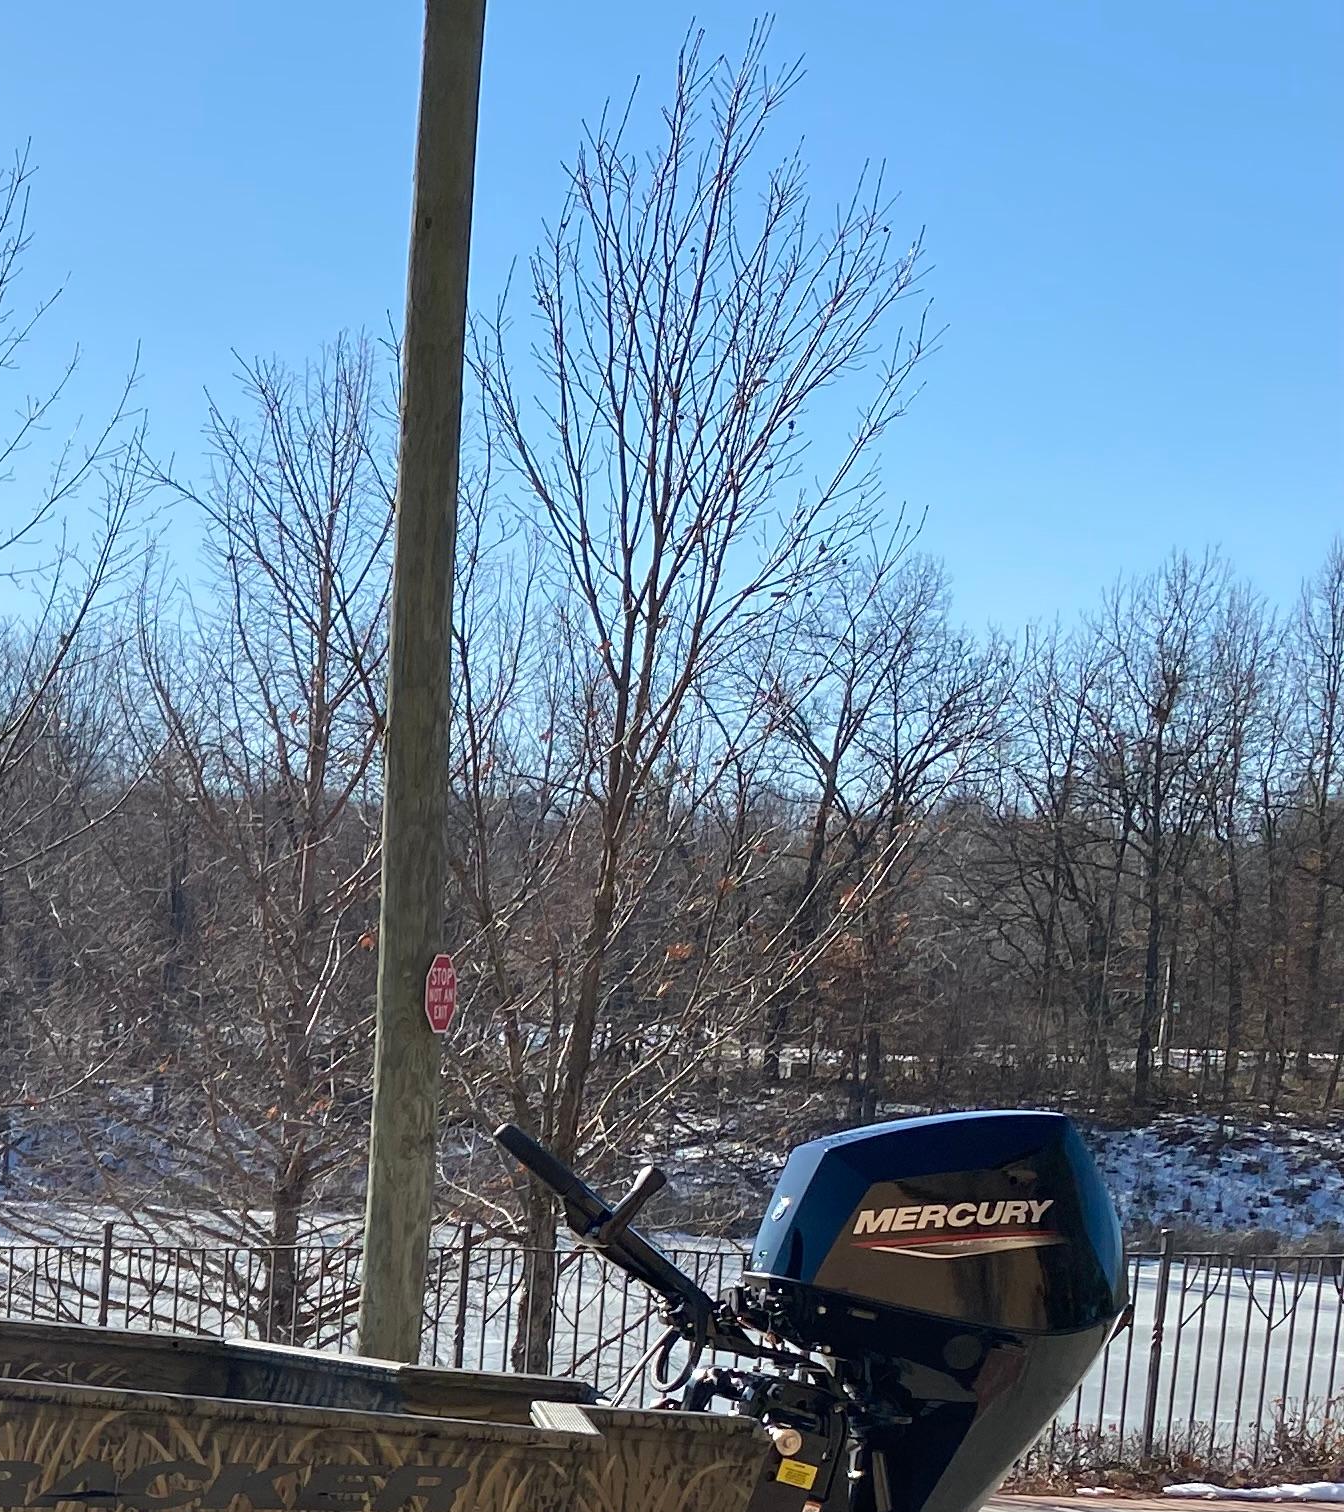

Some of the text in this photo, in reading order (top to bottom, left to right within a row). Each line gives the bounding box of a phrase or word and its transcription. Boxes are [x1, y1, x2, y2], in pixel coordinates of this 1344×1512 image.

[432, 967, 452, 985] STOP
[429, 988, 454, 1002] NOT AN
[433, 1004, 448, 1020] EXIT
[852, 1199, 1054, 1235] MERCURY
